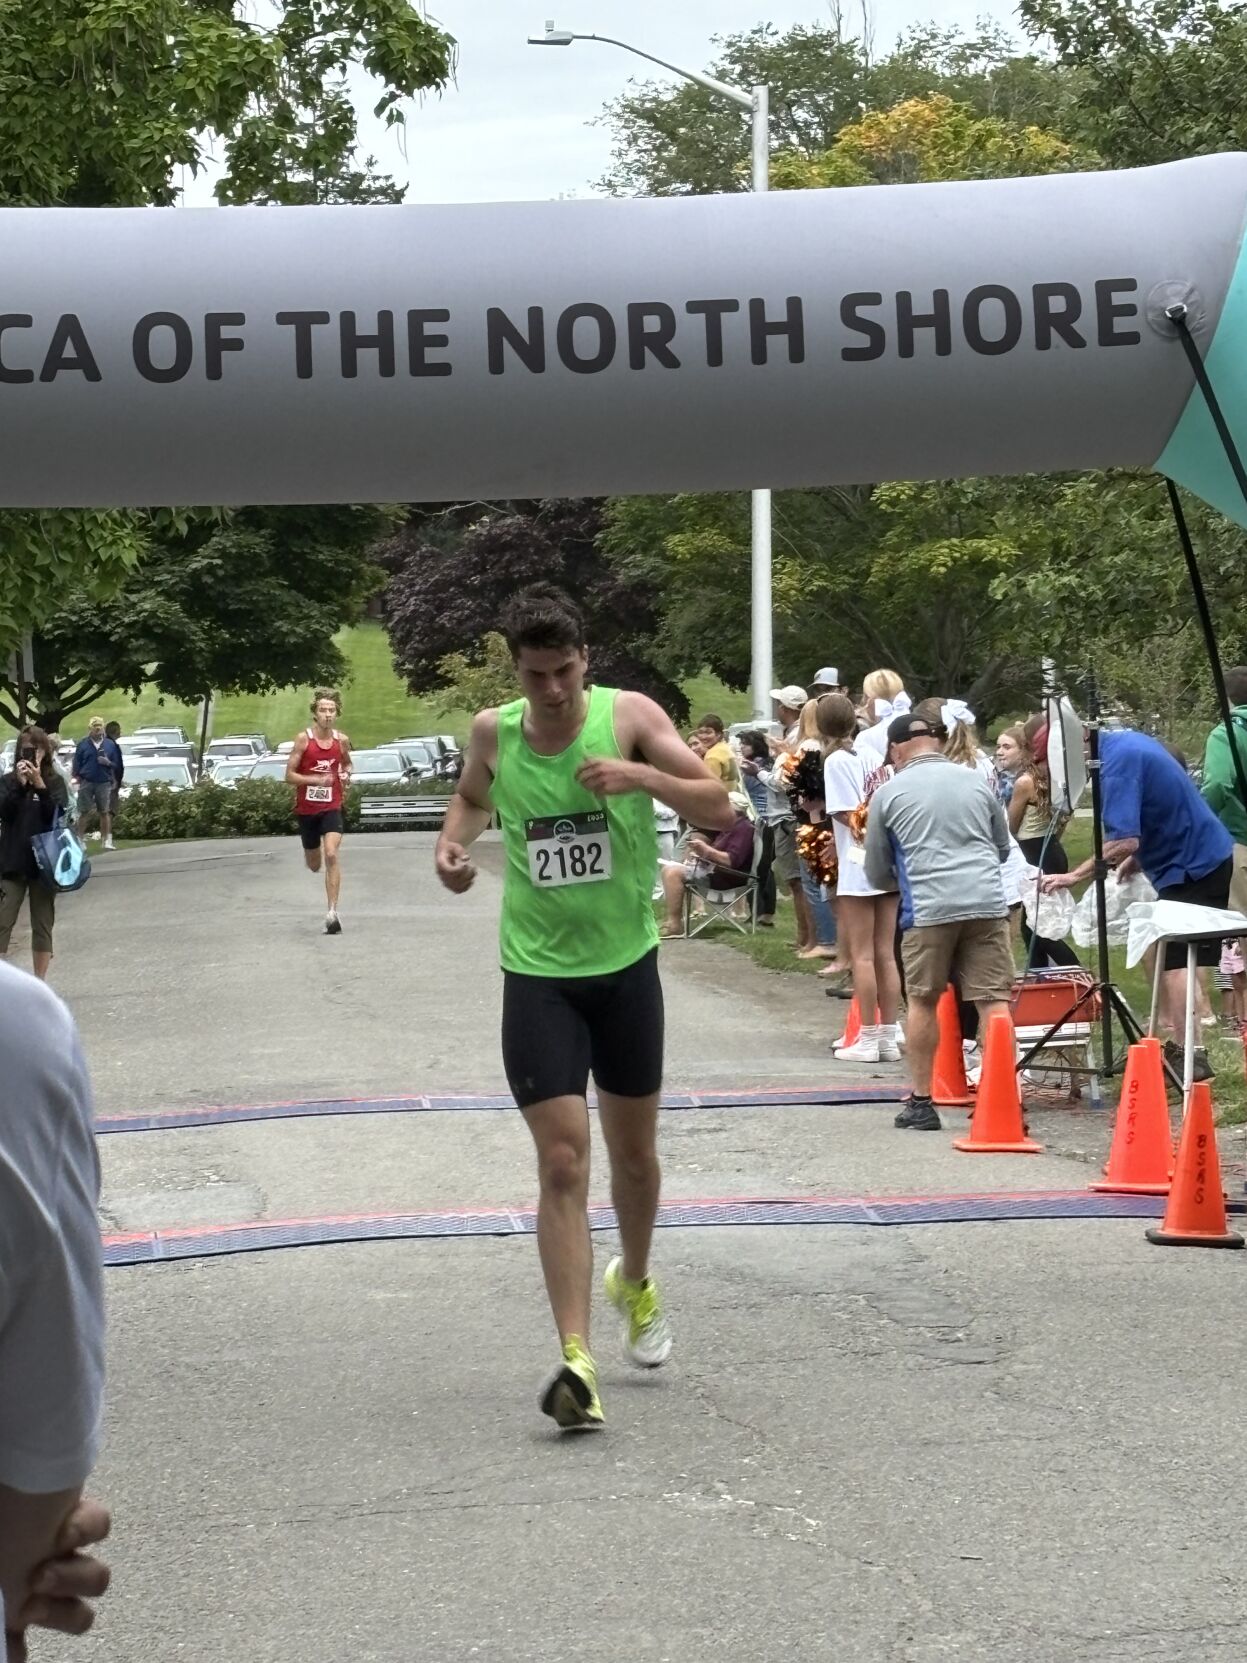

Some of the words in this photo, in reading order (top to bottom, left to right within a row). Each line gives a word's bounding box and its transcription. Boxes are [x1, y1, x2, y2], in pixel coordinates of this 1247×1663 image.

[0, 313, 102, 384] CA
[132, 311, 246, 384] OF
[275, 308, 453, 379] THE
[486, 295, 805, 375] NORTH
[840, 278, 1141, 362] SHORE
[535, 842, 605, 881] 2182
